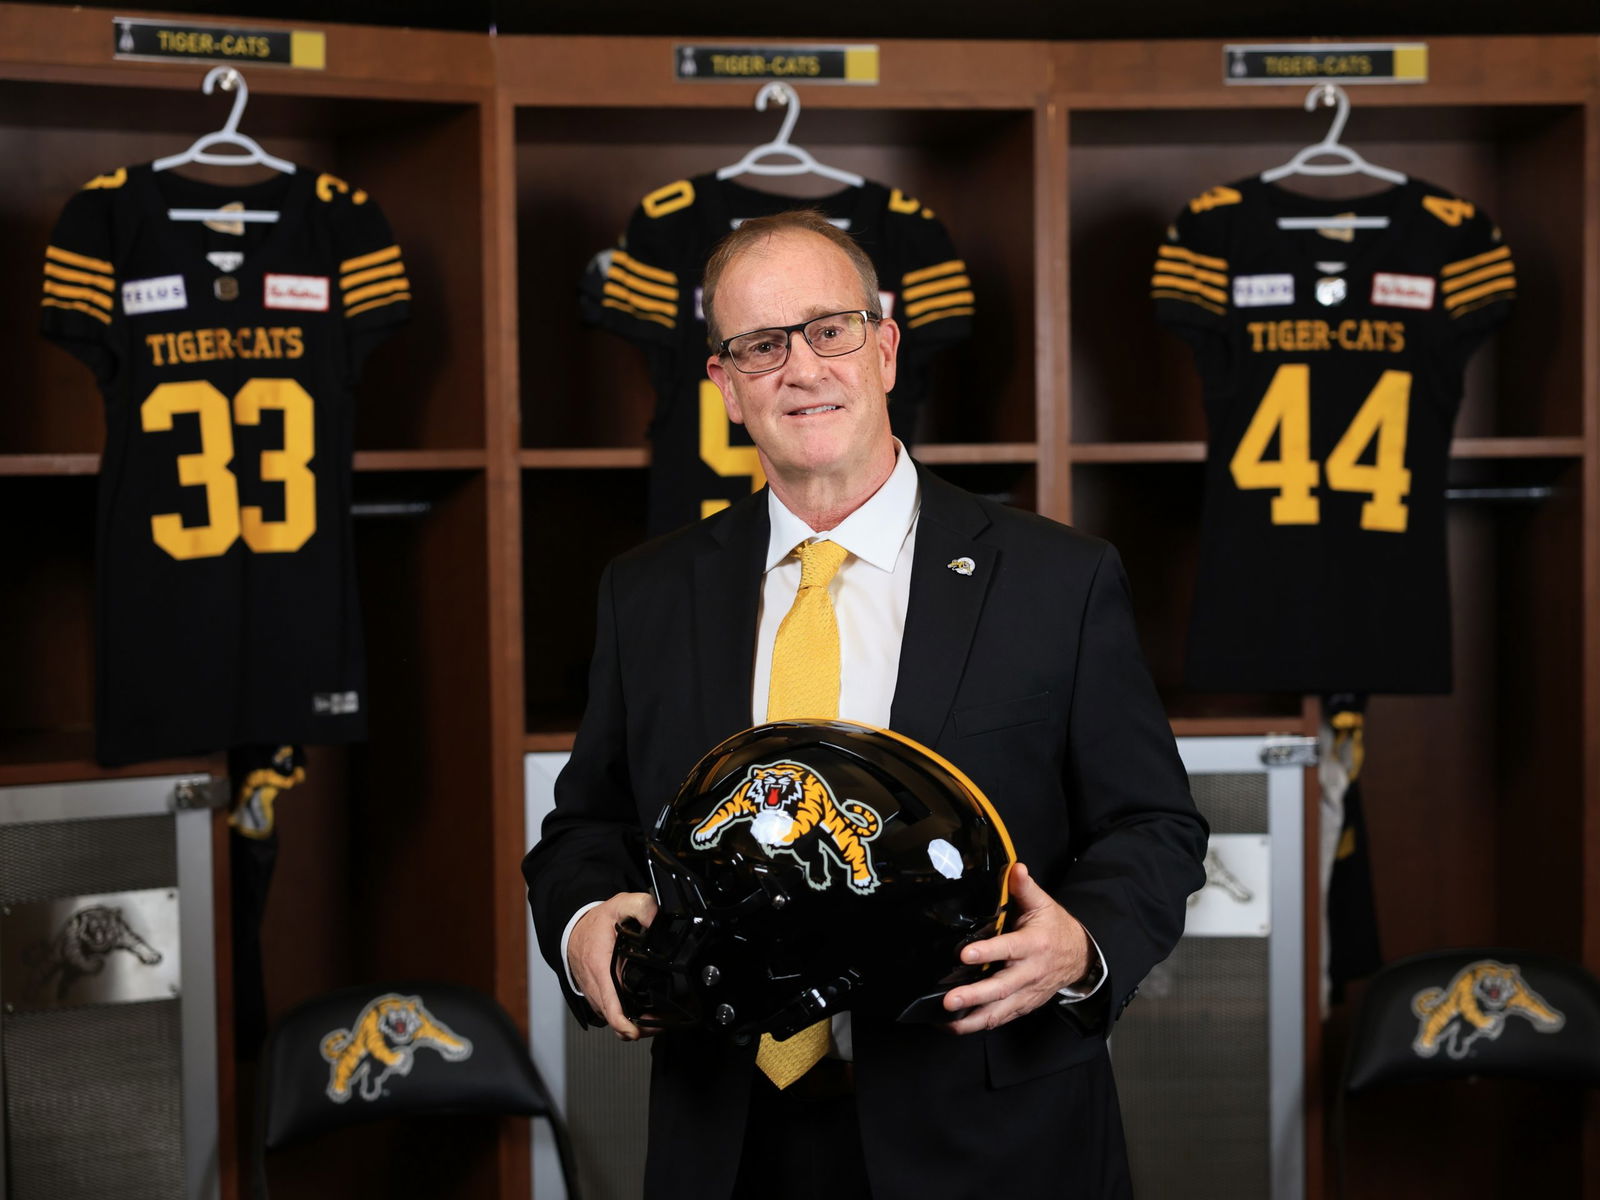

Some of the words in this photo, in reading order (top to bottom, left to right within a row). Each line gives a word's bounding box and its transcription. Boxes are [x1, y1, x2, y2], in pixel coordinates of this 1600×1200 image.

[156, 30, 271, 58] TIGER-CATS
[710, 55, 820, 76] TIGER-CATS
[1263, 55, 1373, 76] TIGER-CATS
[146, 326, 305, 366] TIGER-CATS
[1247, 319, 1406, 353] TIGER-CATS
[1229, 363, 1413, 533] 44
[140, 377, 318, 561] 33
